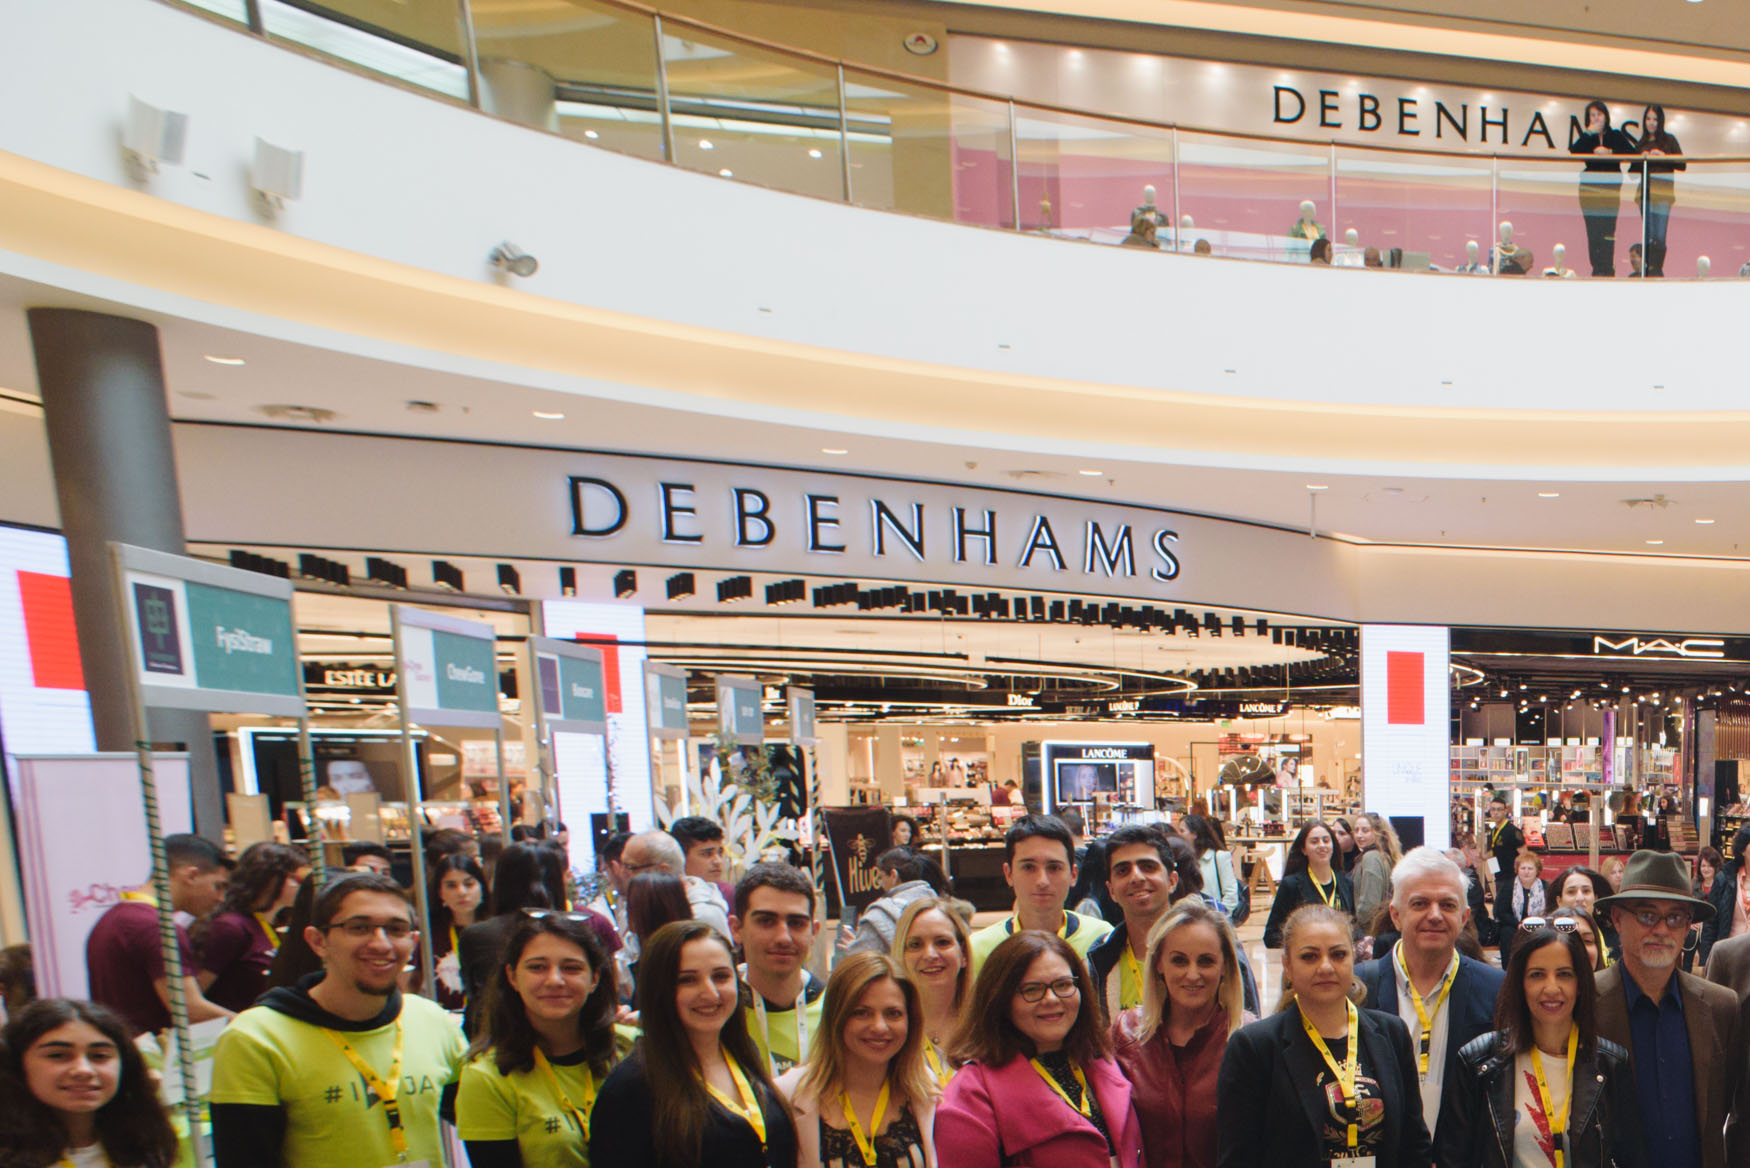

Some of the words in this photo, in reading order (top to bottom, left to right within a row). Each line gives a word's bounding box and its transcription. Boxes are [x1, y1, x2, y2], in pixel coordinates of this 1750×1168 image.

[567, 474, 1182, 583] DEBENHAMS
[1007, 693, 1034, 707] Dior
[1239, 702, 1277, 714] LANCÔME
[1081, 747, 1128, 759] LANCÔME
[848, 855, 881, 894] Hive
